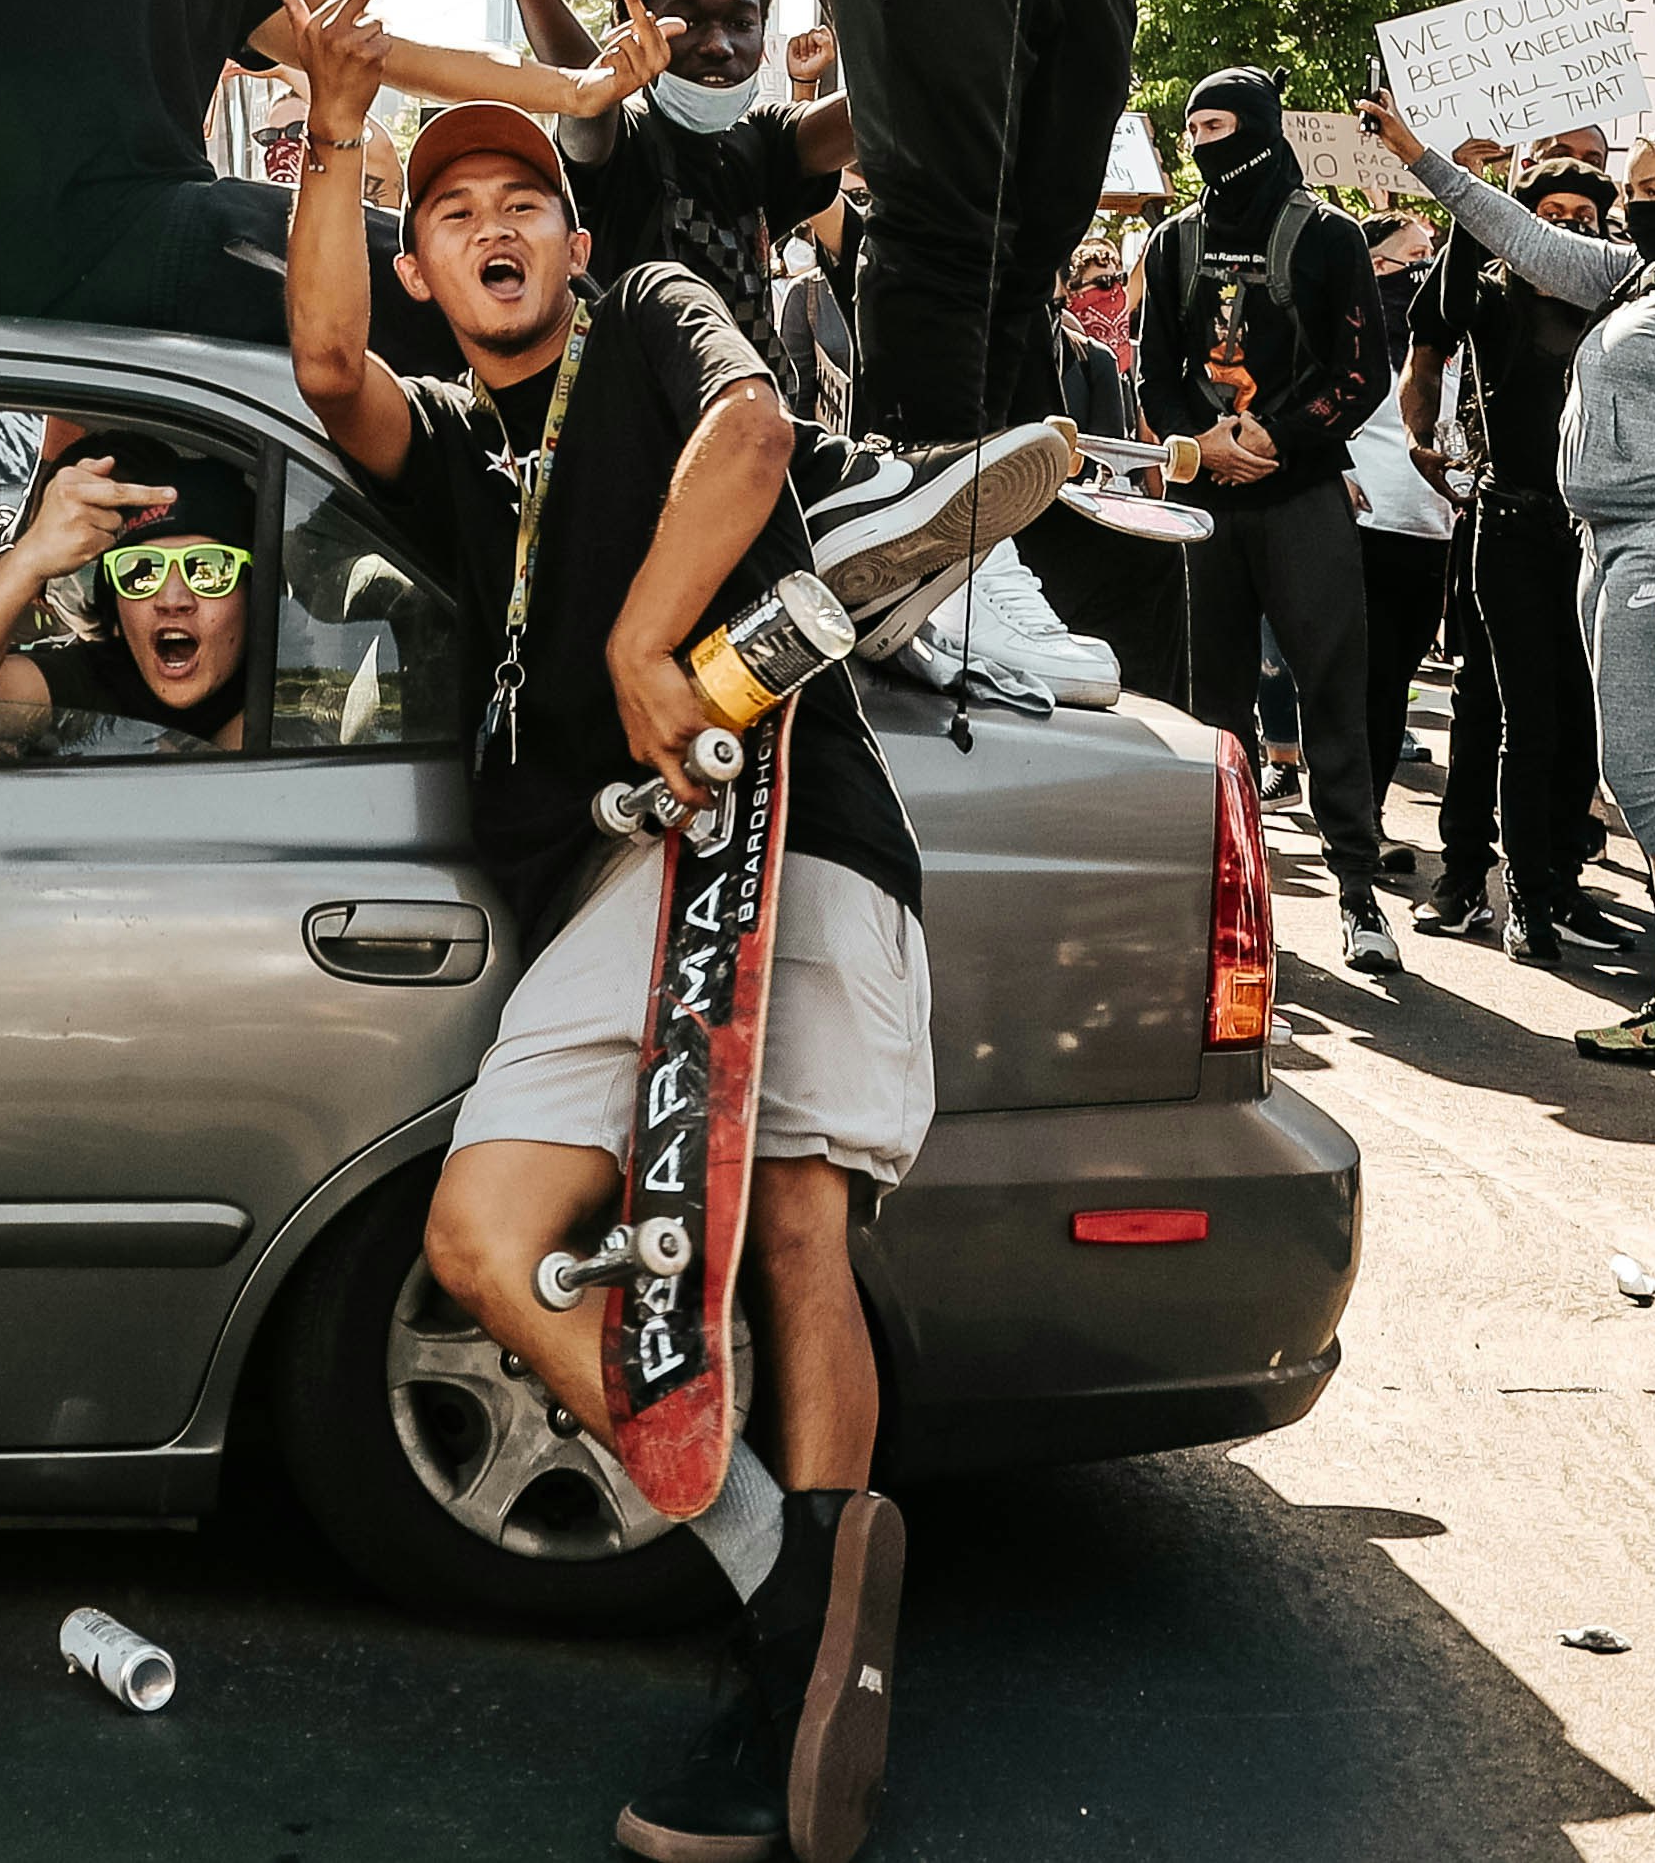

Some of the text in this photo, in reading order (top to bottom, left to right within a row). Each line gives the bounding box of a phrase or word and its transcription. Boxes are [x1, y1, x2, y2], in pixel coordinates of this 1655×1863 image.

[1389, 19, 1453, 60] WE
[1407, 48, 1493, 93] BEEN
[1505, 17, 1628, 64] KNEELING
[1405, 42, 1634, 128] BUT YALL DIDNT
[1466, 102, 1545, 141] LIKE
[1551, 73, 1627, 120] THAT
